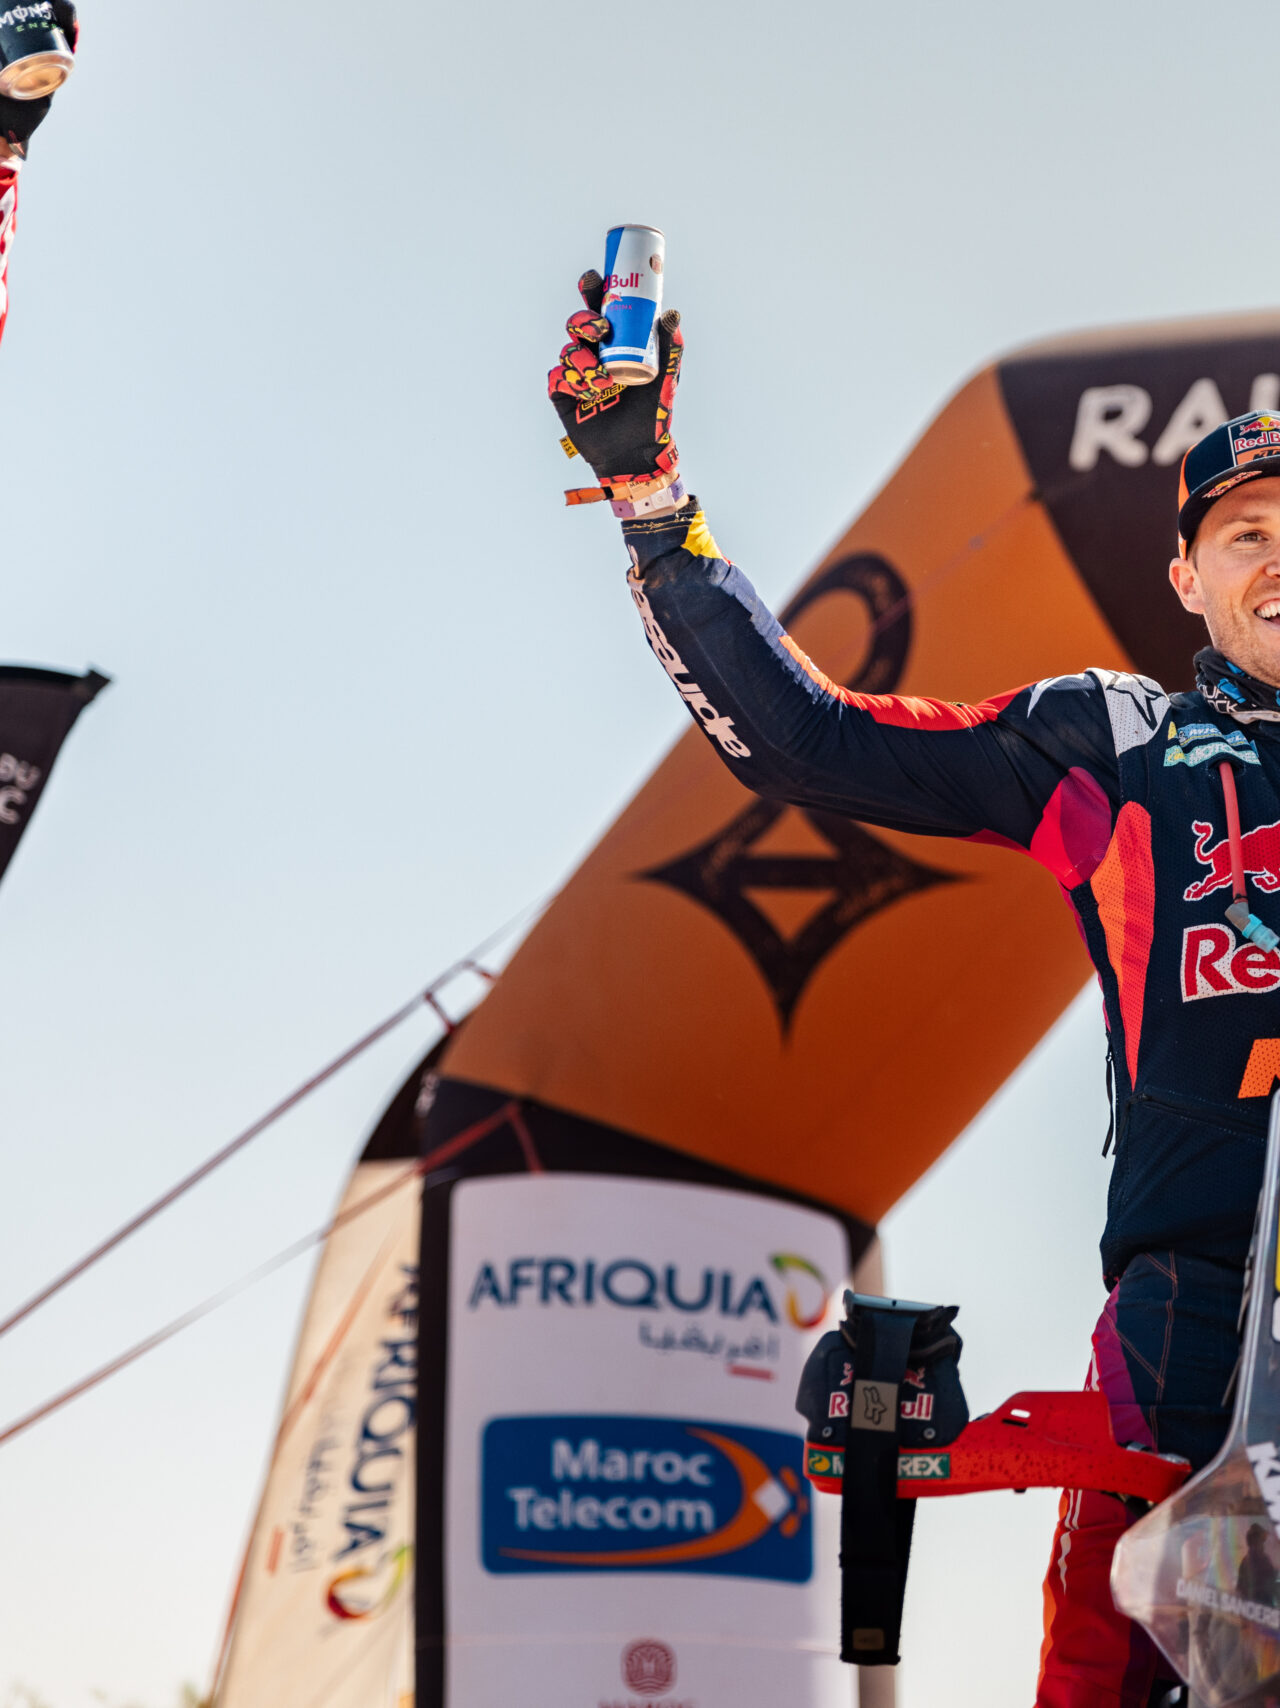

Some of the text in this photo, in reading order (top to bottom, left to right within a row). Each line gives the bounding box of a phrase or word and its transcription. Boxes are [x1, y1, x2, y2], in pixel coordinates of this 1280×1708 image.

[1235, 433, 1268, 452] Red
[468, 1255, 778, 1326] AFRIQUIA
[901, 1393, 933, 1420] ull
[551, 1438, 714, 1486] Maroc
[508, 1487, 715, 1533] Telecom
